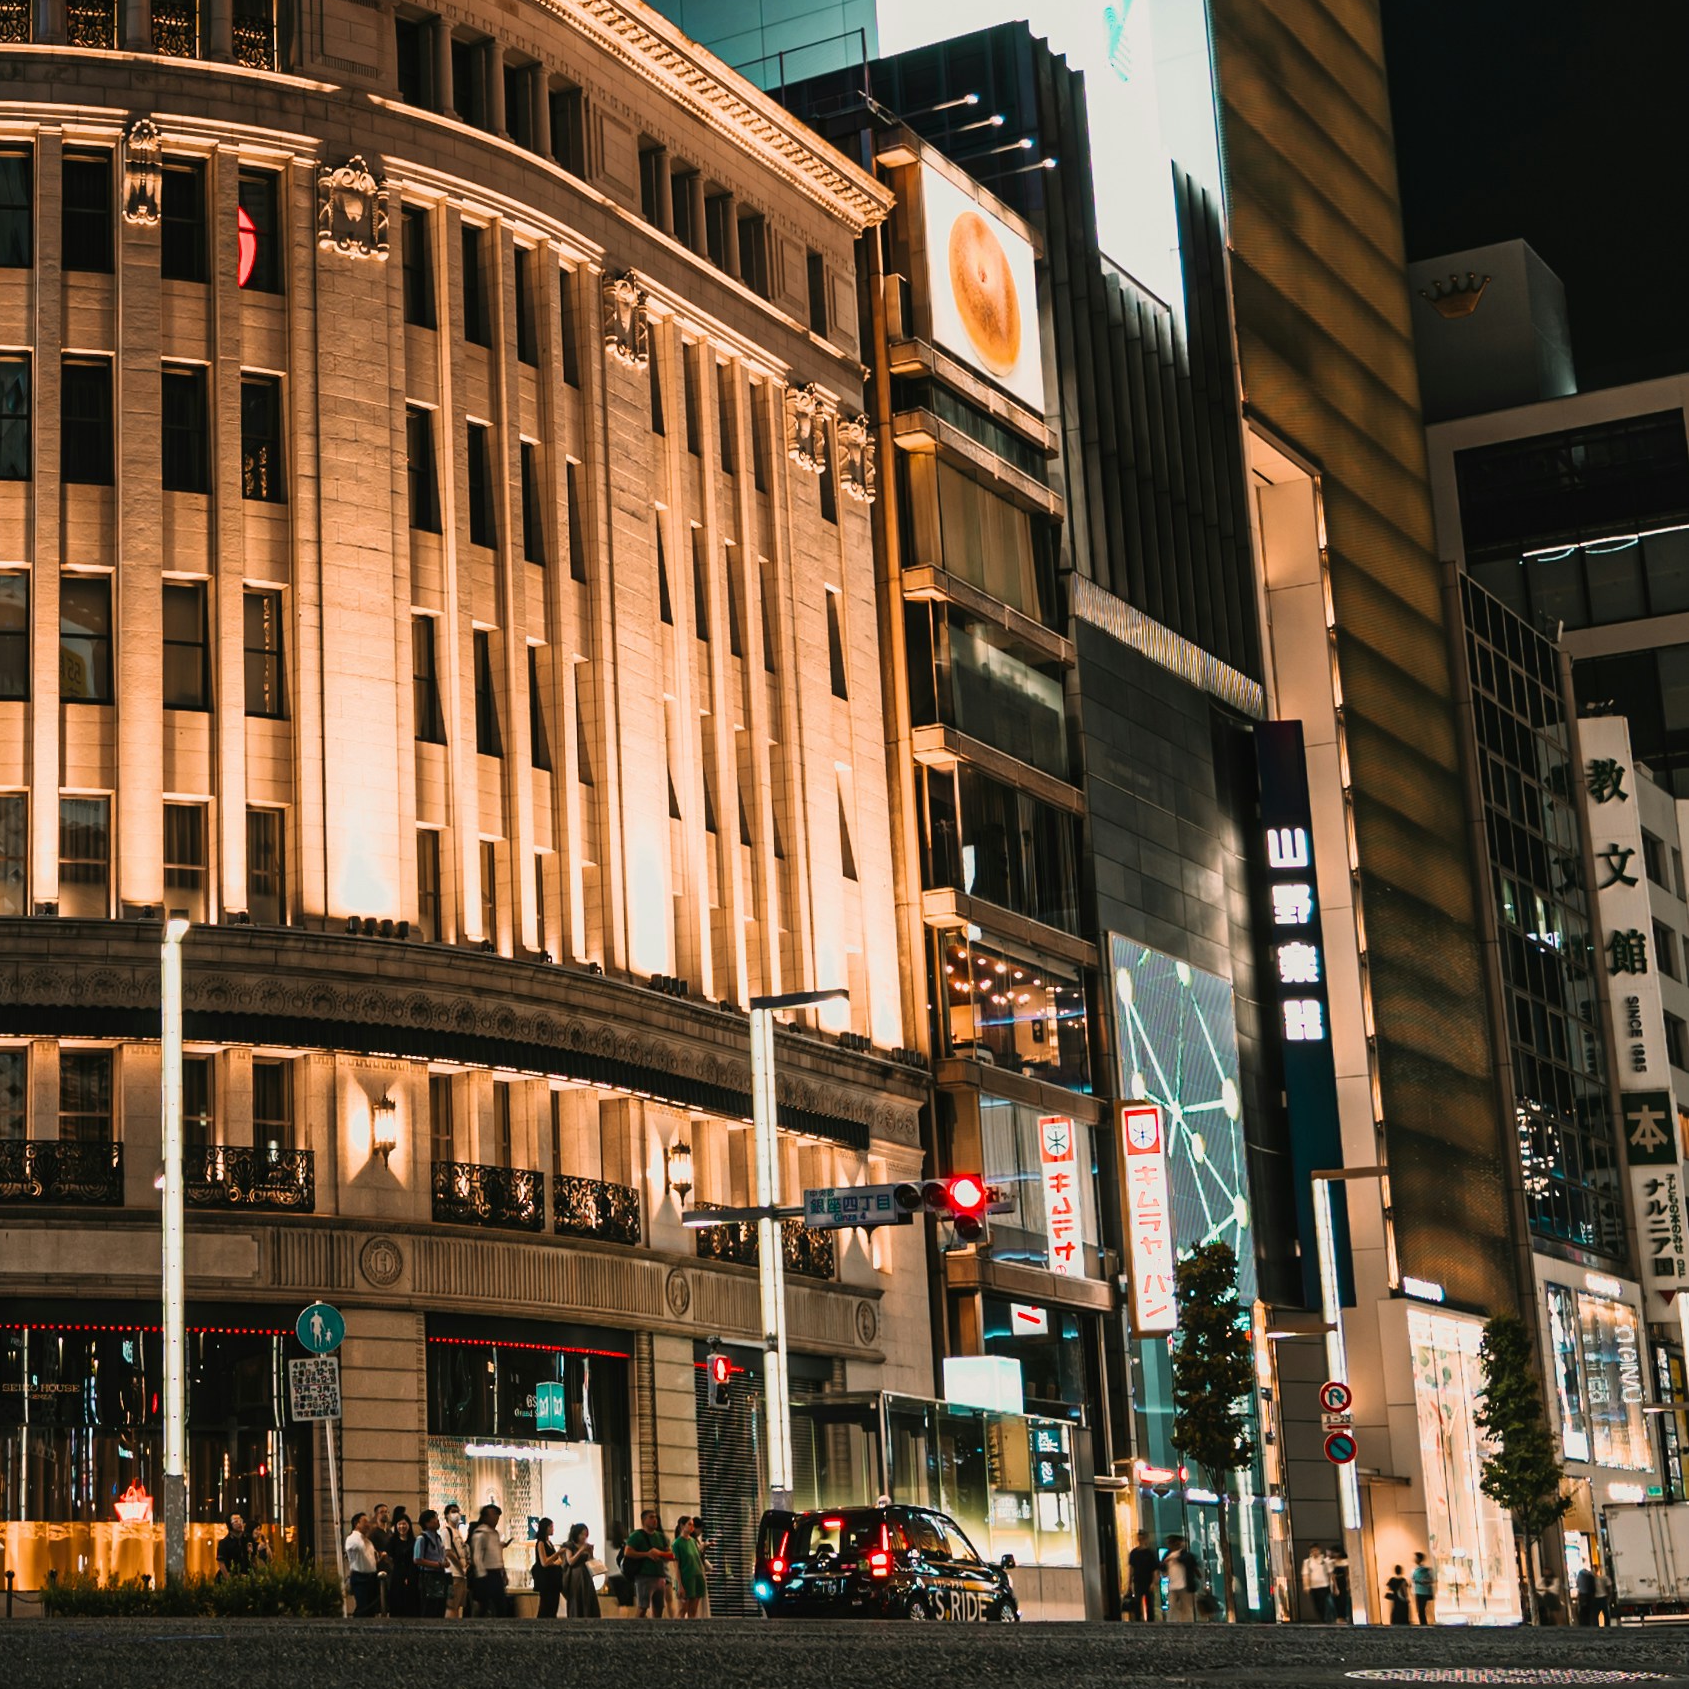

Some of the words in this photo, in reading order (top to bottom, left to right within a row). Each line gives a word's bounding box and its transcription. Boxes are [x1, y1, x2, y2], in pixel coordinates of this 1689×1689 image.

[1584, 757, 1648, 977] 教文館
[1624, 995, 1643, 1038] SINCE
[1628, 1042, 1648, 1073] 1885
[1626, 1104, 1669, 1153] 本
[810, 1194, 890, 1214] 銀座四丁目
[834, 1212, 858, 1222] Ginza
[860, 1212, 866, 1220] 4
[1133, 1165, 1176, 1319] キムラヤパン
[1643, 1177, 1676, 1277] ナルニア国
[40, 1383, 81, 1393] HOUSE
